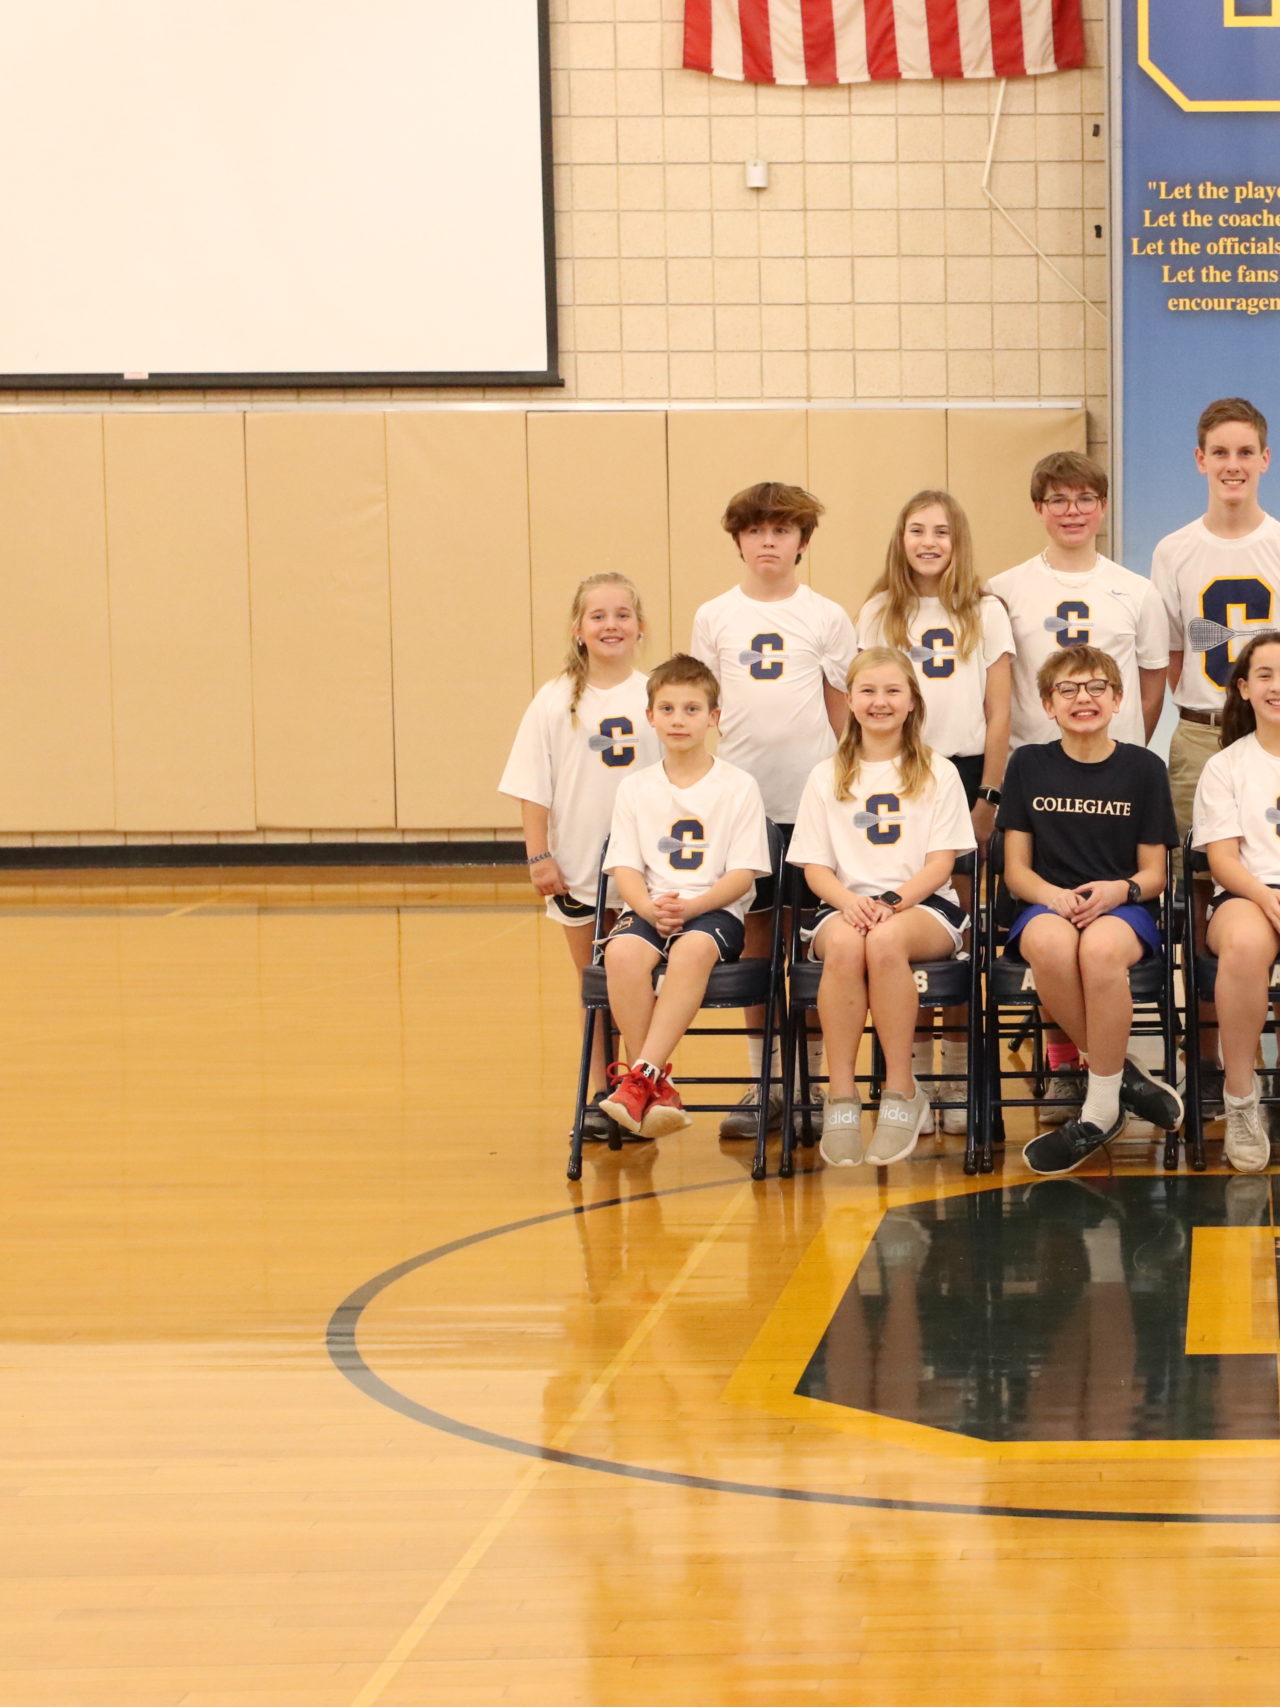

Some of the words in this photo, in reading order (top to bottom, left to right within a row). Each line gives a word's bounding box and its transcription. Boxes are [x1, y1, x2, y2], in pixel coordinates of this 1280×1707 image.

[1148, 181, 1192, 199] "Let
[1198, 181, 1230, 199] the
[1143, 209, 1177, 227] Let
[1182, 209, 1213, 227] the
[1131, 237, 1165, 255] Let
[1170, 237, 1201, 255] the
[1162, 265, 1195, 283] Let
[1201, 265, 1232, 283] the
[1237, 265, 1279, 283] fans
[1055, 600, 1090, 647] C
[1199, 575, 1275, 691] C
[750, 632, 784, 681] C
[921, 627, 956, 679] C
[599, 716, 636, 768] C
[865, 792, 902, 846] C
[1032, 796, 1131, 816] COLLEGIATE
[668, 818, 705, 871] C
[879, 1105, 914, 1123] didas
